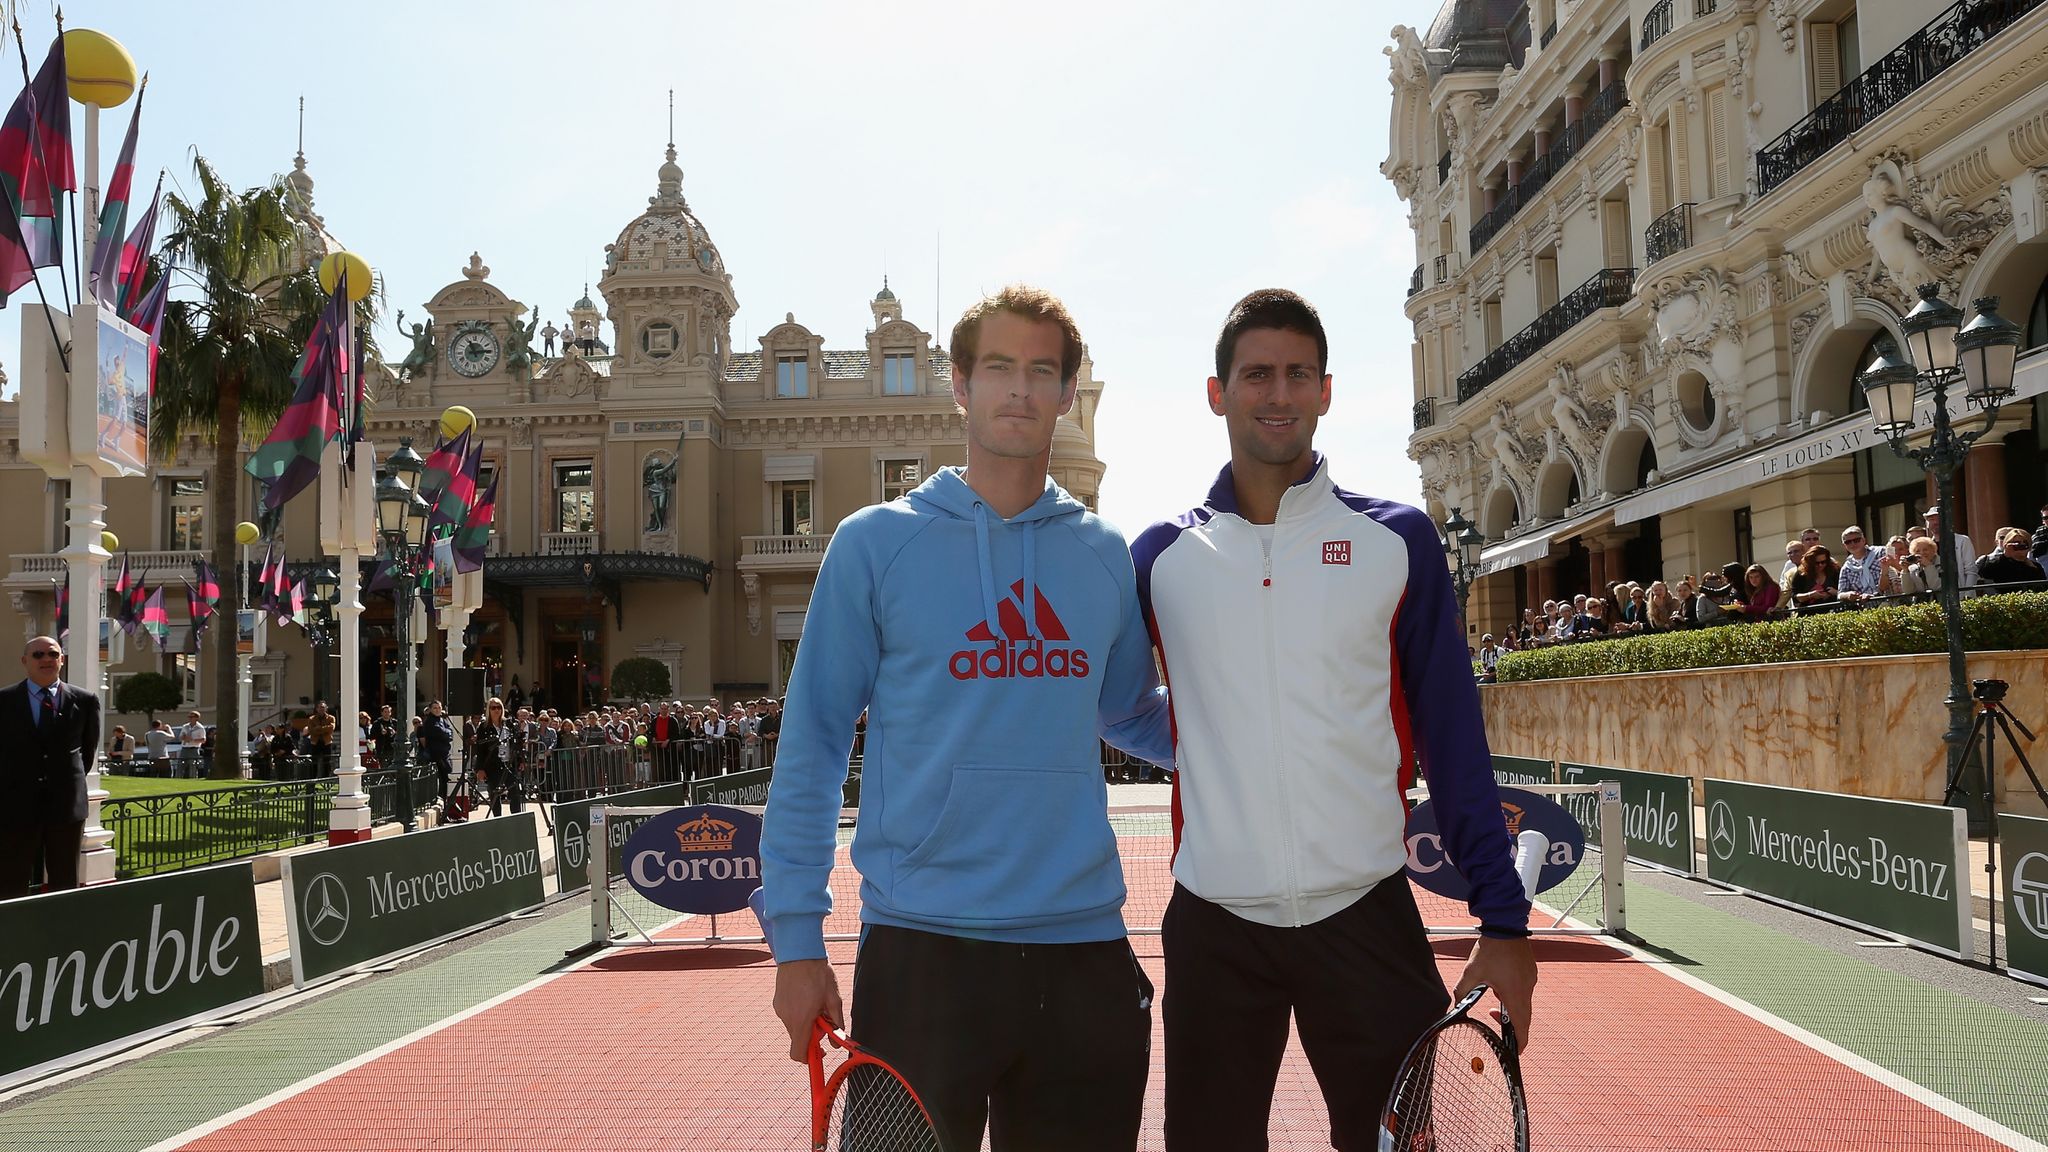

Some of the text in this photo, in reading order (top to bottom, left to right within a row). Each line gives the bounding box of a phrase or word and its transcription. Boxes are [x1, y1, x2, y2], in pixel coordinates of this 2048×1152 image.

[1761, 429, 1864, 477] LE LOUIS XV
[1325, 543, 1346, 552] UNI
[1325, 552, 1348, 563] QLO
[949, 639, 1090, 681] adidas
[631, 850, 759, 888] Coron
[1747, 815, 1949, 901] Mercedes-Benz
[366, 847, 538, 919] Mercedes-Benz
